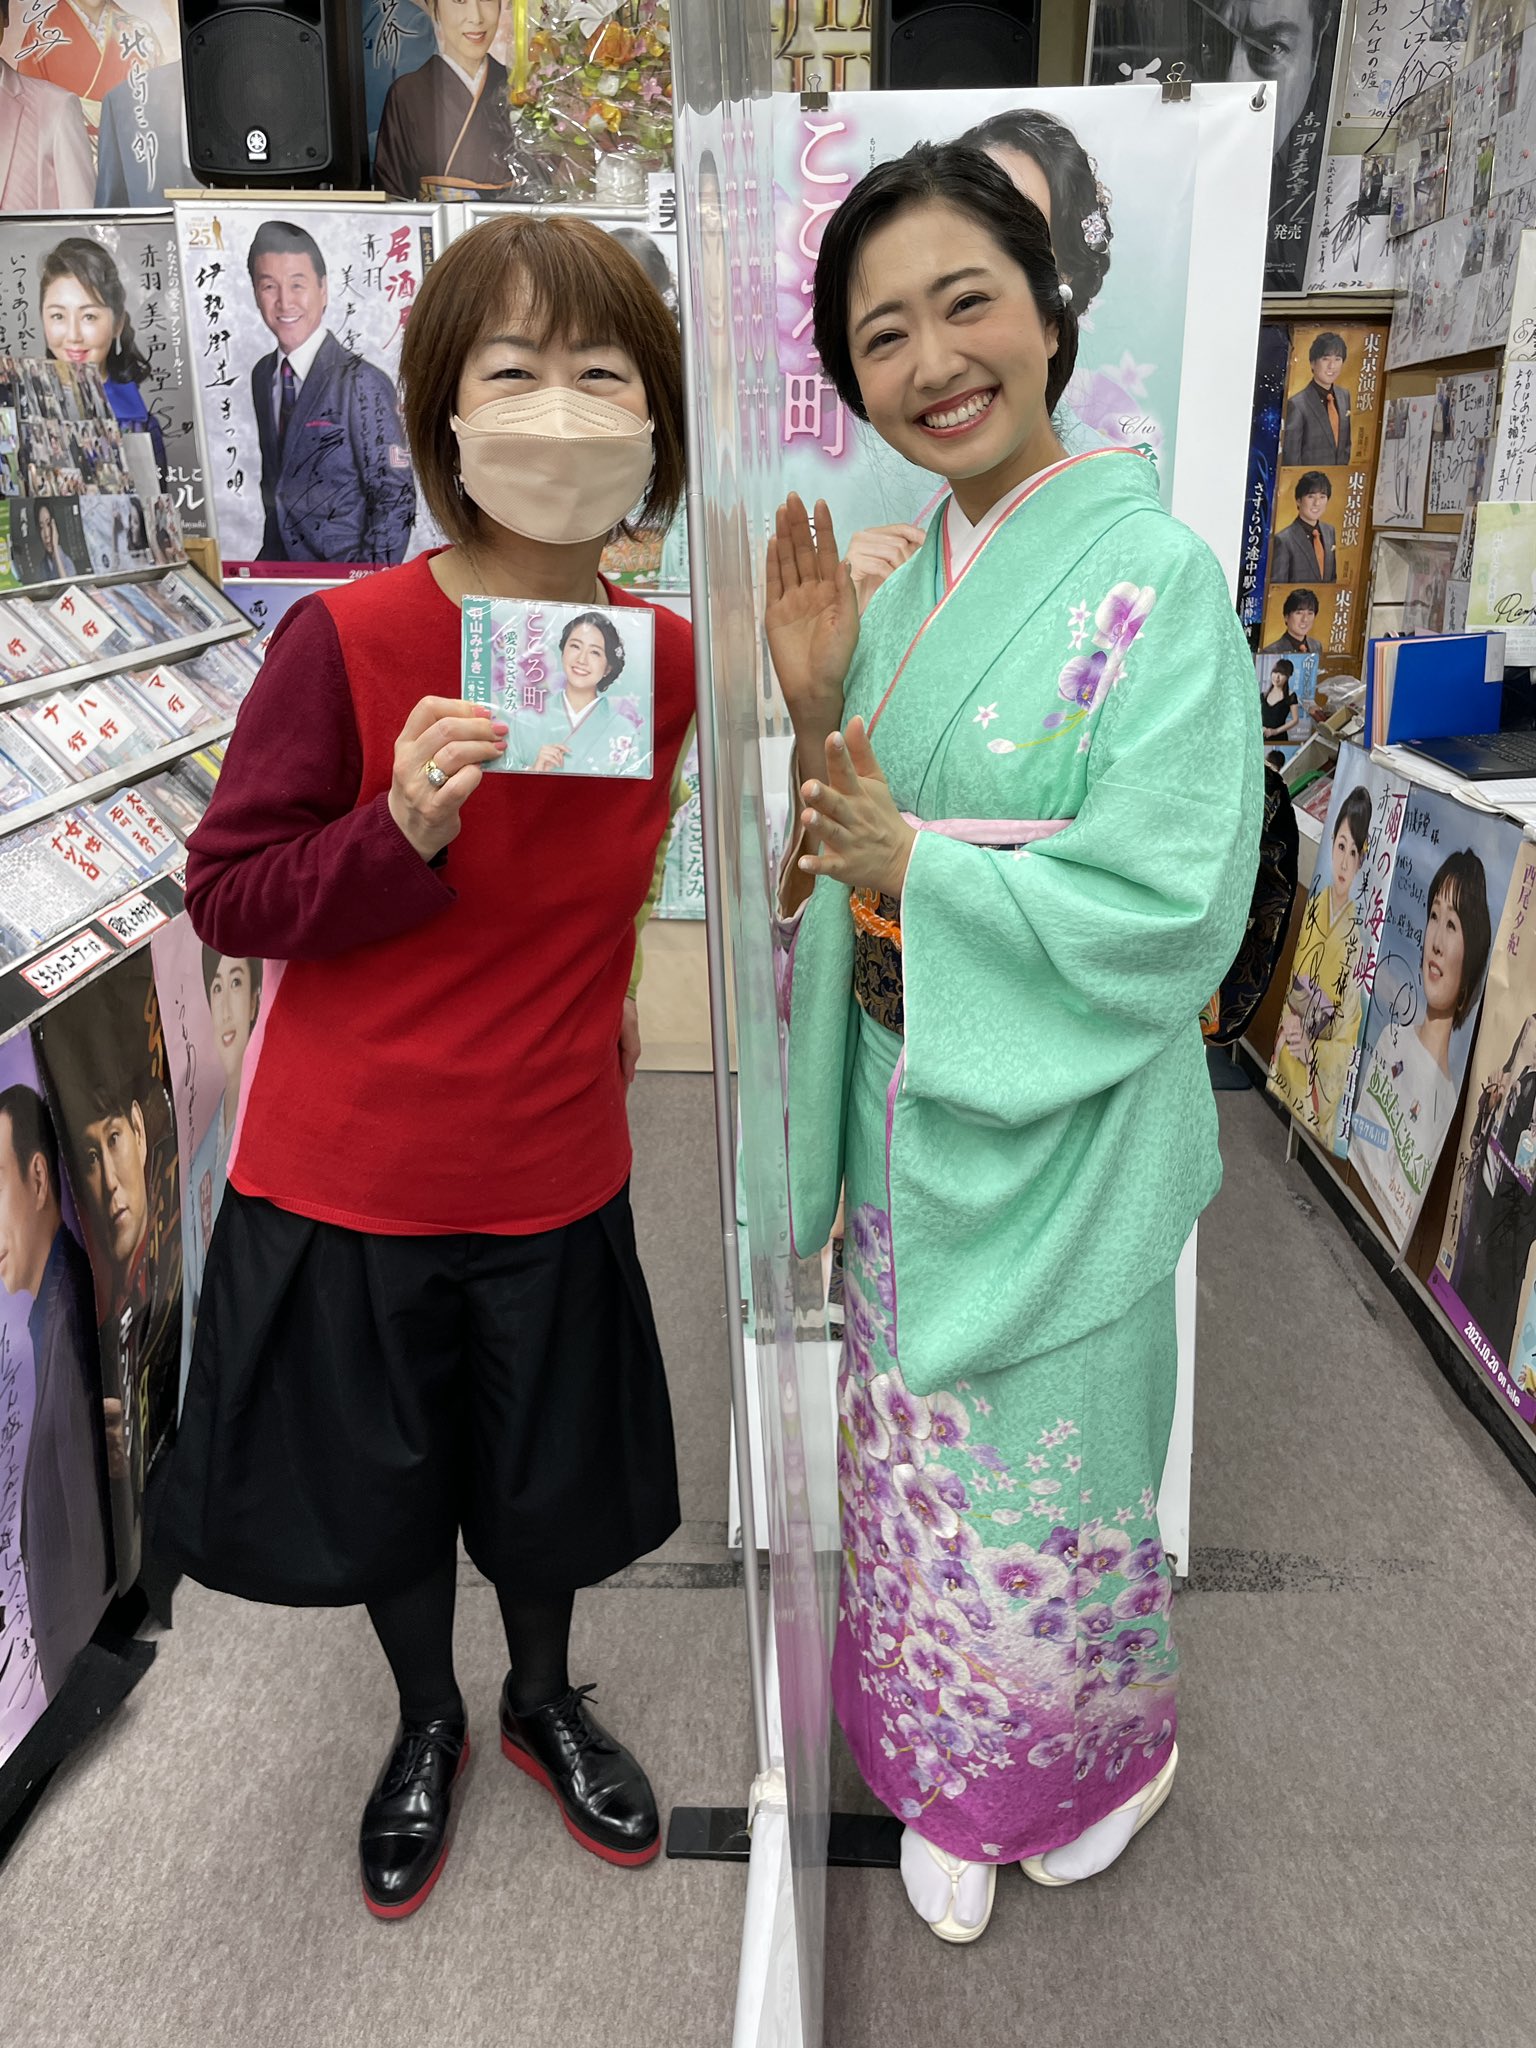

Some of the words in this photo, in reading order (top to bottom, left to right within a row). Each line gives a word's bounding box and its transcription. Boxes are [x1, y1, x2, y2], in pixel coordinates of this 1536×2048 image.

[188, 229, 211, 247] 25
[1274, 223, 1302, 240] 発売
[138, 245, 178, 393] 赤羽美声堂
[1356, 333, 1382, 412] 東京演歌
[1341, 471, 1366, 546] 東京演歌
[504, 631, 518, 711] 愛のさざなみ
[523, 613, 548, 713] こころ町
[1352, 793, 1408, 991] 雨の海峡
[1463, 1321, 1500, 1375] 2021.10.20
[1497, 1371, 1507, 1388] on
[1506, 1383, 1521, 1407] sale
